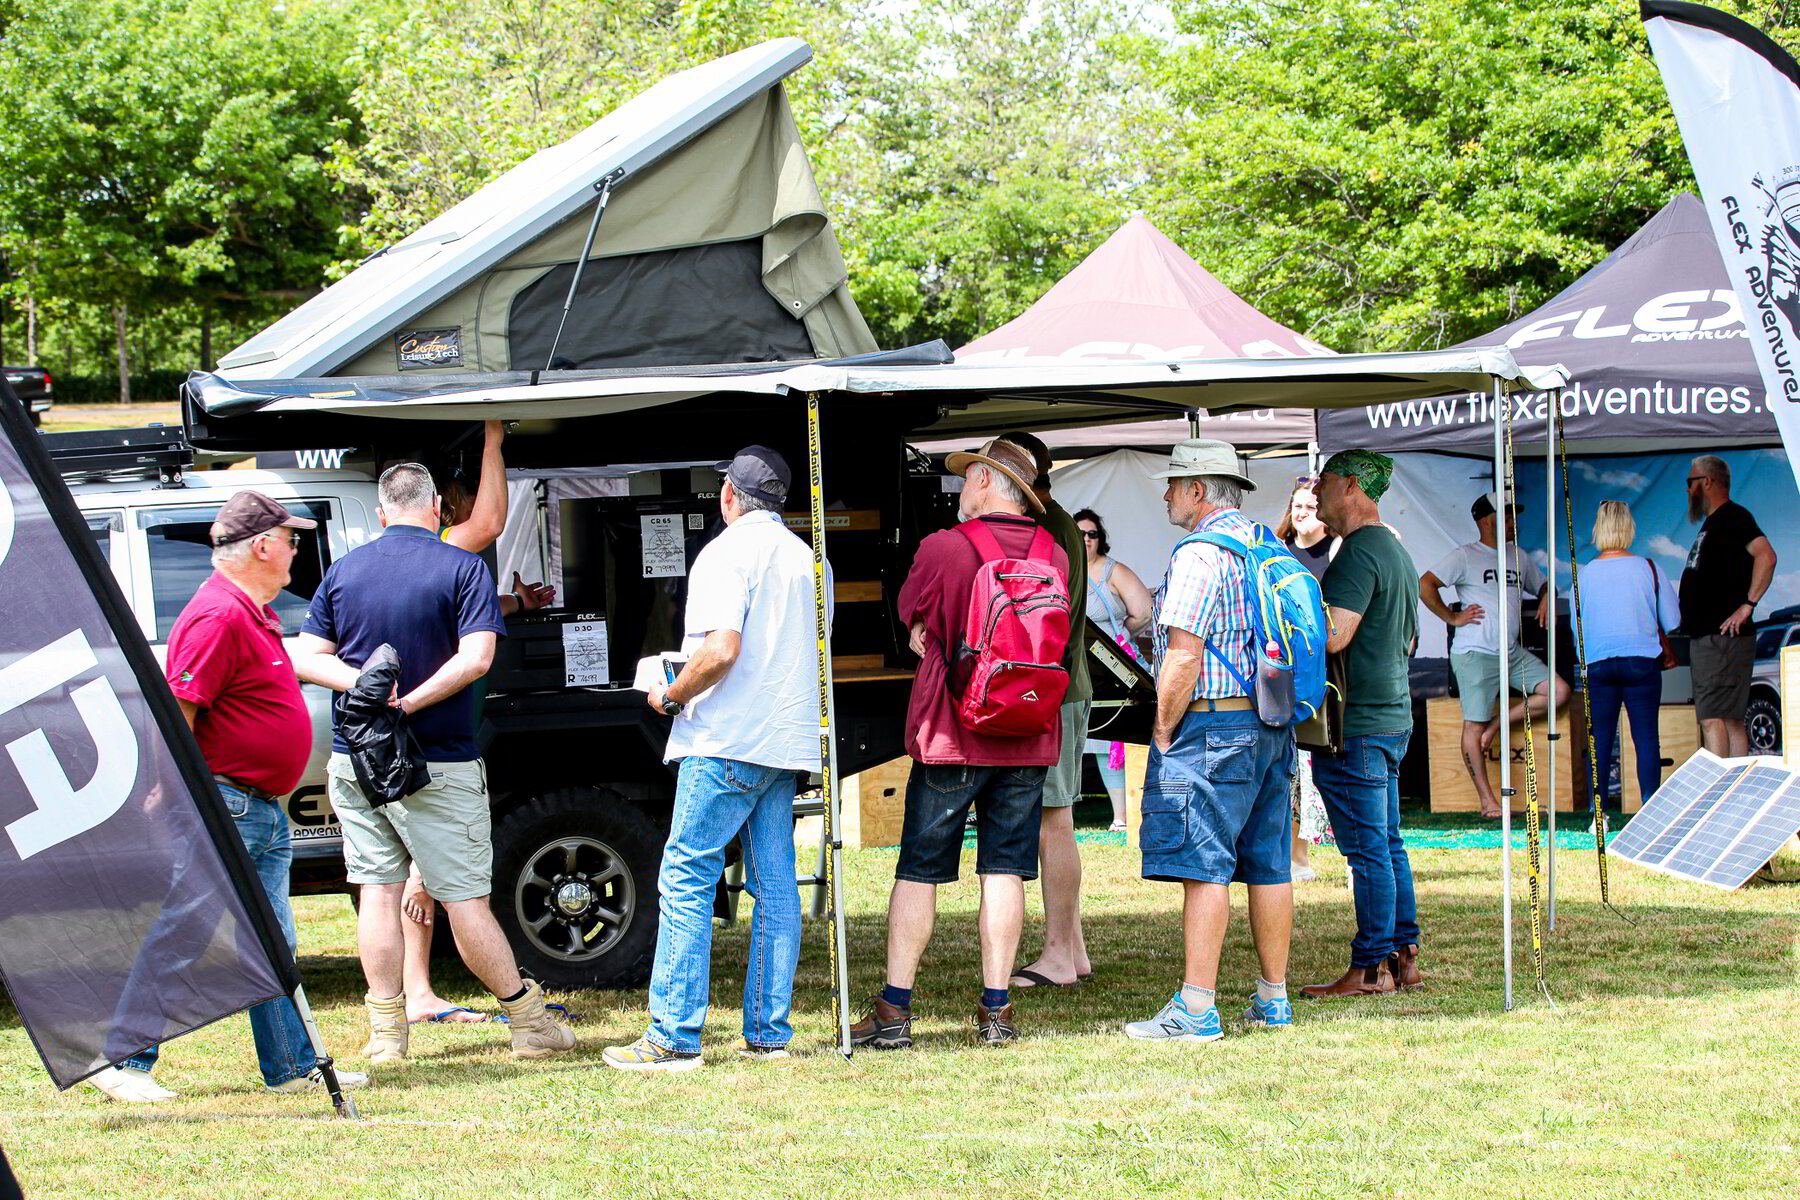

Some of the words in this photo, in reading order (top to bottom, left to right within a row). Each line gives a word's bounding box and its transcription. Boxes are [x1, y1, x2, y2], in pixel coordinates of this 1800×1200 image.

[1721, 195, 1753, 254] FLEX
[400, 335, 458, 355] Custom
[645, 565, 653, 575] R
[568, 674, 576, 683] R
